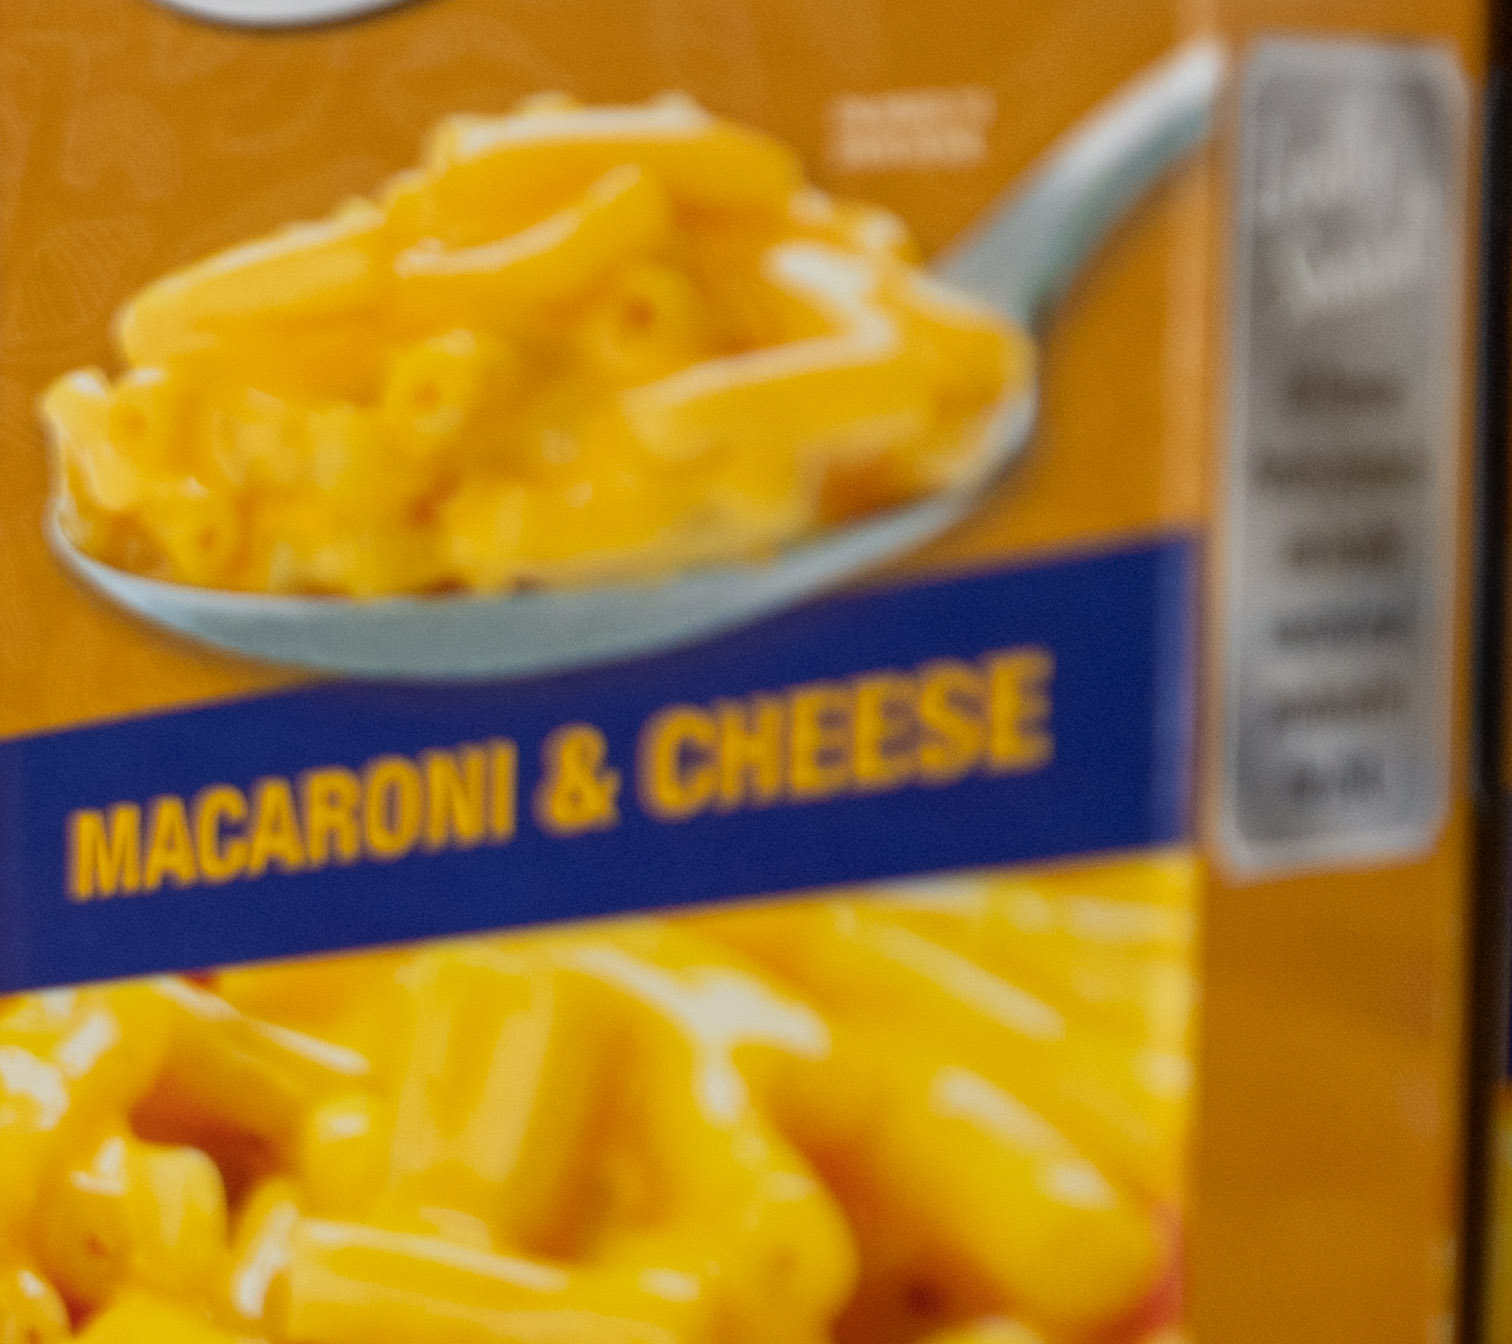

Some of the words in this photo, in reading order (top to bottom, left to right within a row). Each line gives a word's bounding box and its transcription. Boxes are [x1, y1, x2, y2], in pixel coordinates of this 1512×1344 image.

[68, 738, 518, 901] MACARONI
[534, 724, 621, 833] &
[637, 649, 1056, 821] CHEESE
